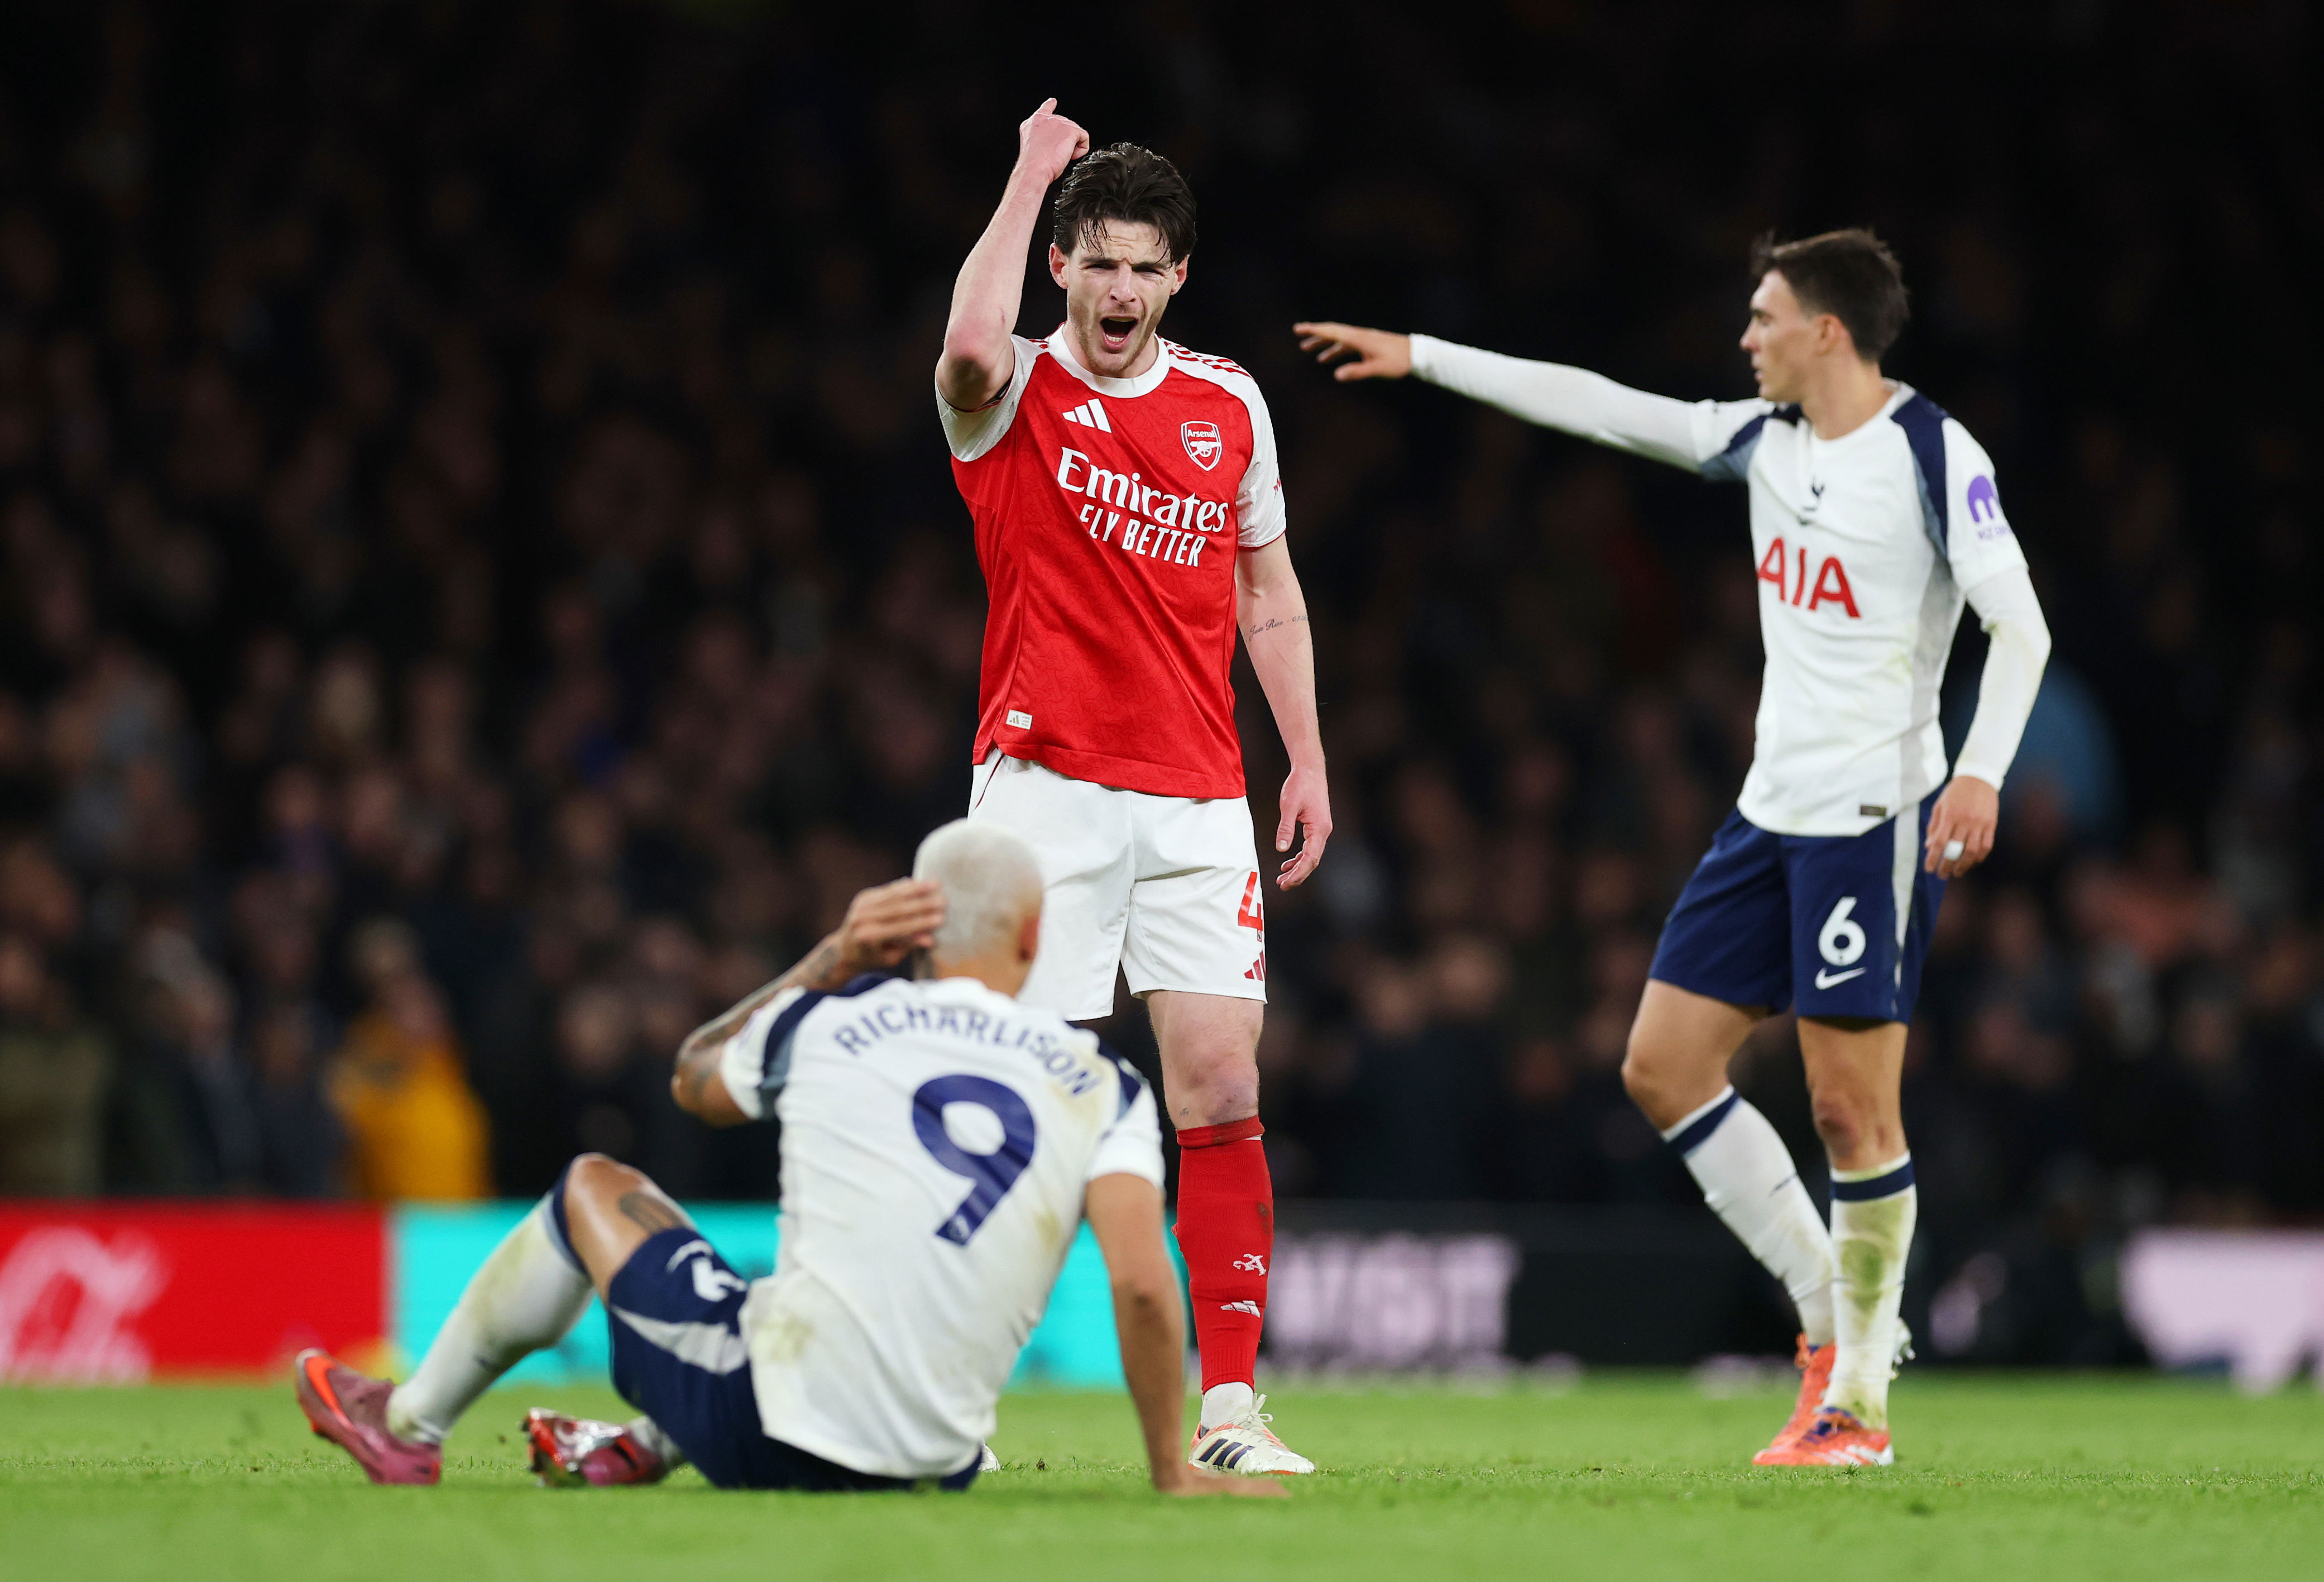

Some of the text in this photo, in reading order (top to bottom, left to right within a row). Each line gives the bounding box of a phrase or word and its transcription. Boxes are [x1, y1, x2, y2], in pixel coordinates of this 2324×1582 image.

[1187, 429, 1216, 438] Arsenal
[1057, 447, 1228, 533] Emirates
[1080, 504, 1206, 567] FLY BETTER
[1756, 537, 1861, 619] AIA
[1238, 871, 1263, 943] 4
[1818, 896, 1866, 967] 6
[833, 1001, 1101, 1098] RICHARLISON
[911, 1073, 1038, 1246] 9
